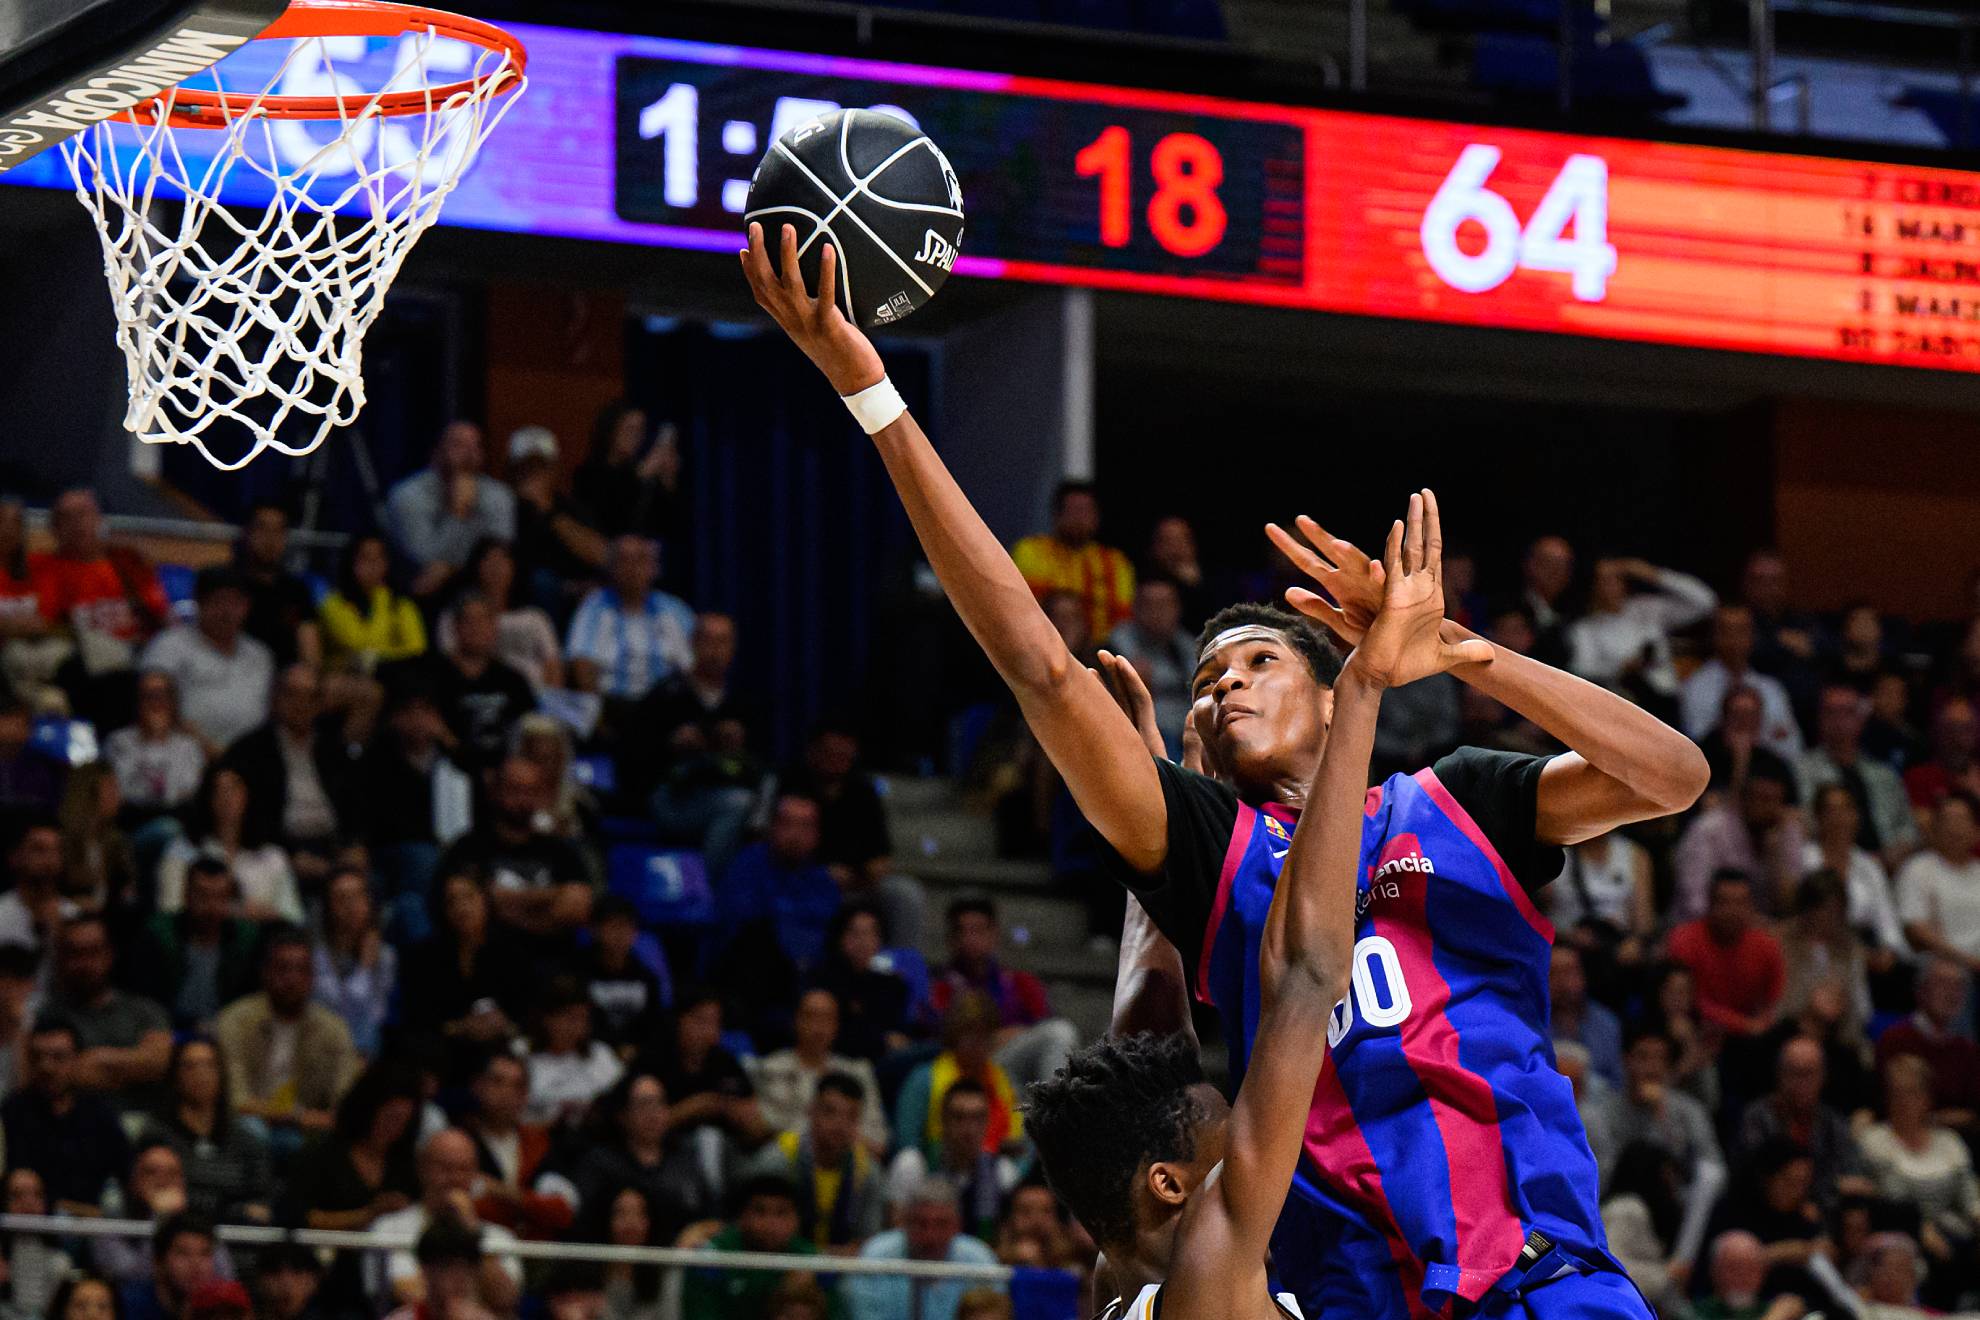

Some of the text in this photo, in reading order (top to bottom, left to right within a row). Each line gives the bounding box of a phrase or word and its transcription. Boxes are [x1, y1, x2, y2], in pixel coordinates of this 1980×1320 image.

[9, 28, 249, 131] MINICOPA
[1074, 124, 1228, 258] 18
[1420, 143, 1618, 302] 64
[914, 229, 958, 272] SPAL
